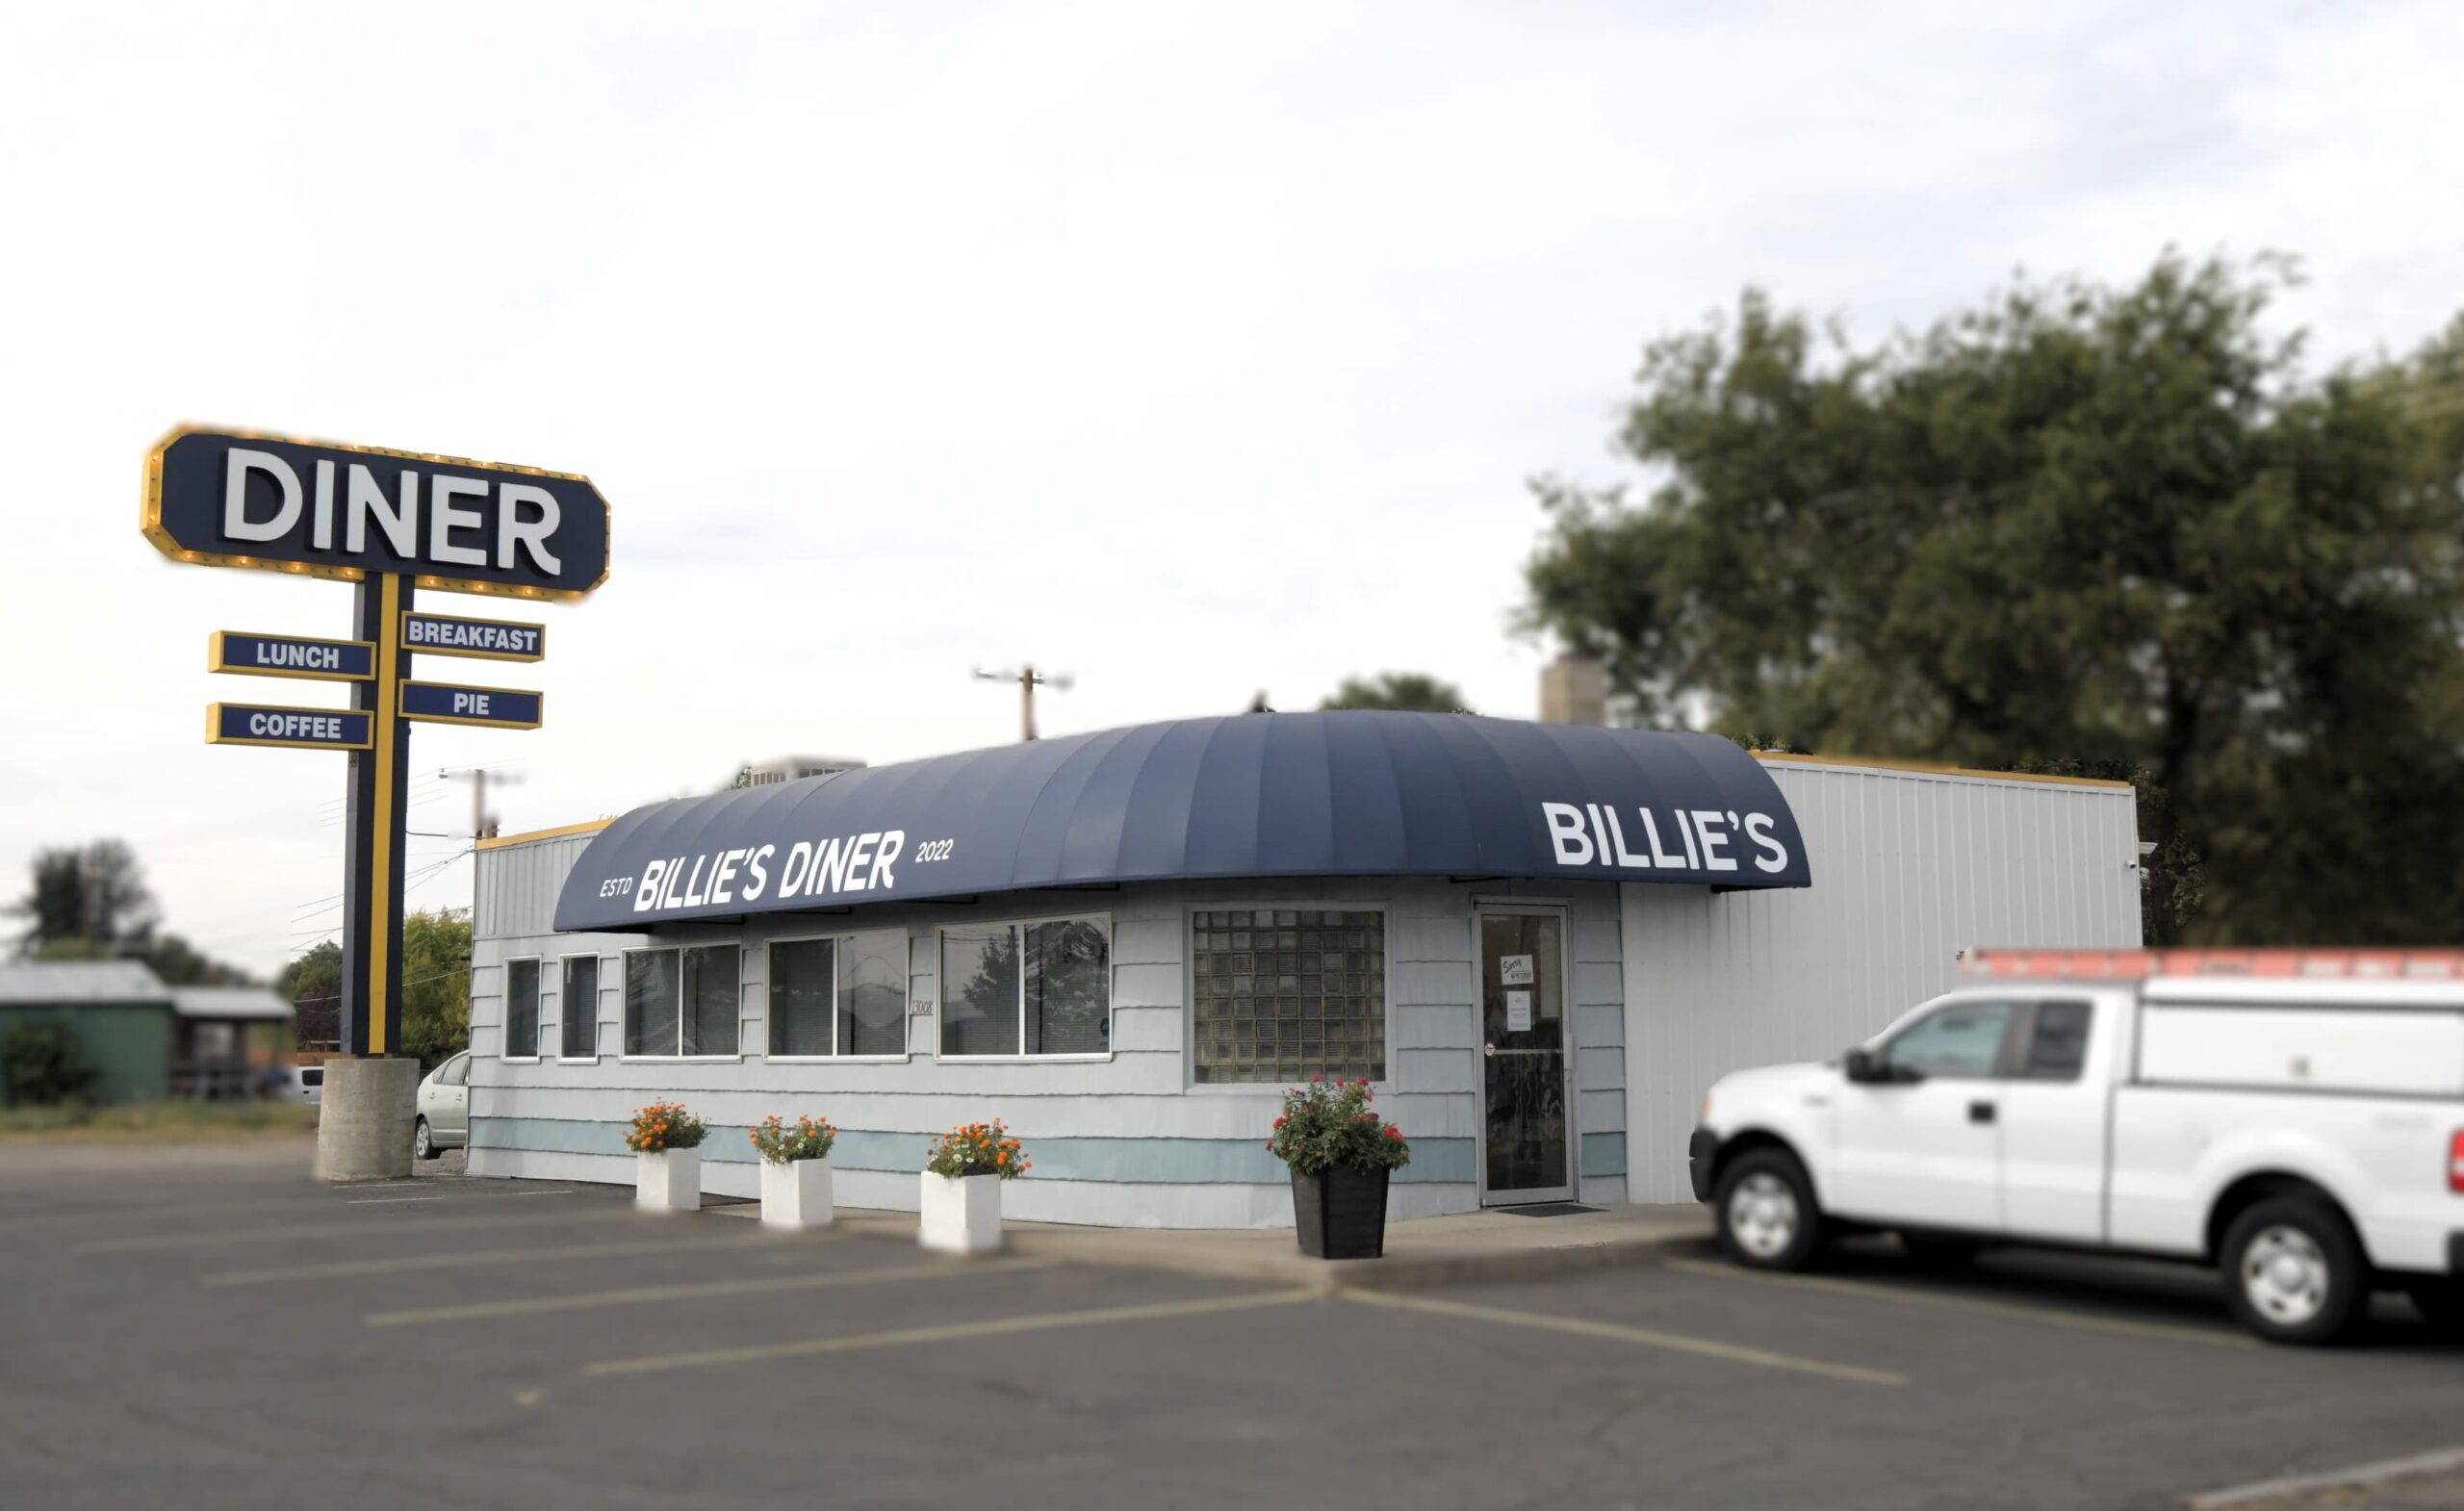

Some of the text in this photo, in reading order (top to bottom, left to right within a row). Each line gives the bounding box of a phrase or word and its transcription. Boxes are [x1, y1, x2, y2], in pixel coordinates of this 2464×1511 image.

[224, 447, 561, 576] DINER
[409, 620, 537, 652] BREAKFAST
[257, 642, 339, 669] LUNCH
[453, 693, 489, 715] PIE
[249, 712, 342, 739] COFFEE
[1542, 802, 1787, 873] BILLIE'S
[600, 831, 954, 911] ESTD BILLIE'S DINER 2022
